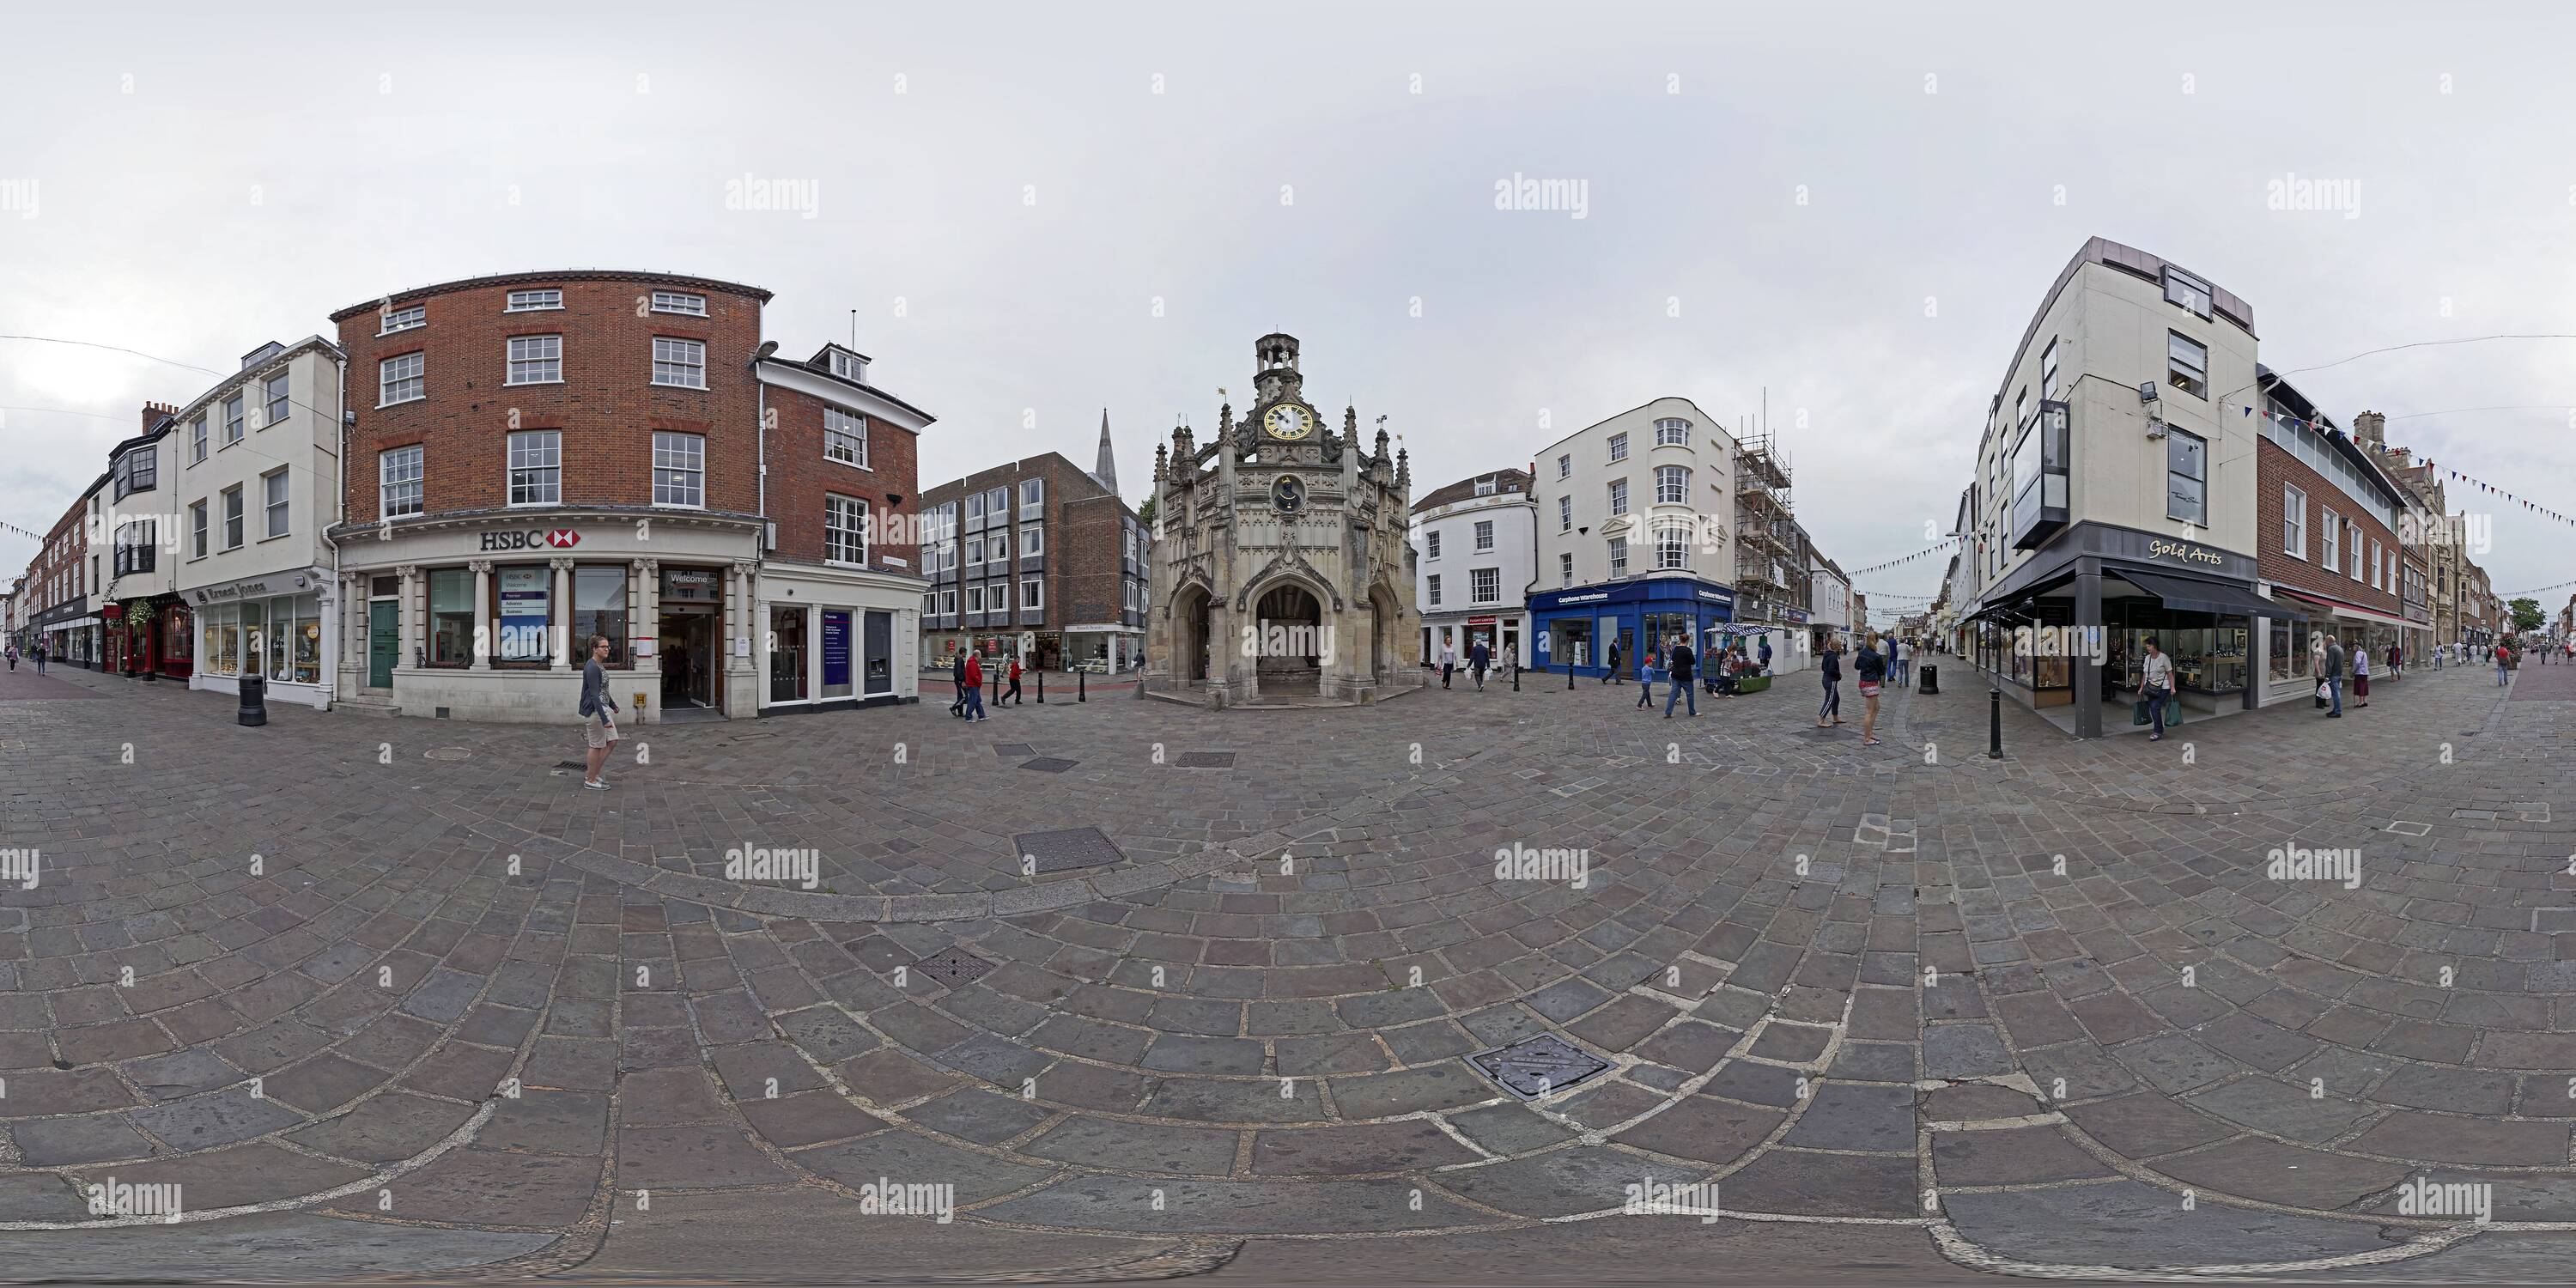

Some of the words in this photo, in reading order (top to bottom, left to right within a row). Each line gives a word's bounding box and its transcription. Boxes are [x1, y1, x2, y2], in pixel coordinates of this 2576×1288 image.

[480, 530, 544, 551] HSBC
[2148, 539, 2188, 563] Gold
[2189, 547, 2222, 565] Arts
[671, 573, 708, 584] Welcome
[207, 586, 237, 600] Ernest
[236, 581, 266, 599] Jones
[1698, 589, 1715, 598] Carphone
[1714, 592, 1731, 602] Warehouse
[1558, 595, 1580, 604] Carphone
[1580, 592, 1608, 601] Warehouse
[636, 694, 645, 704] H
